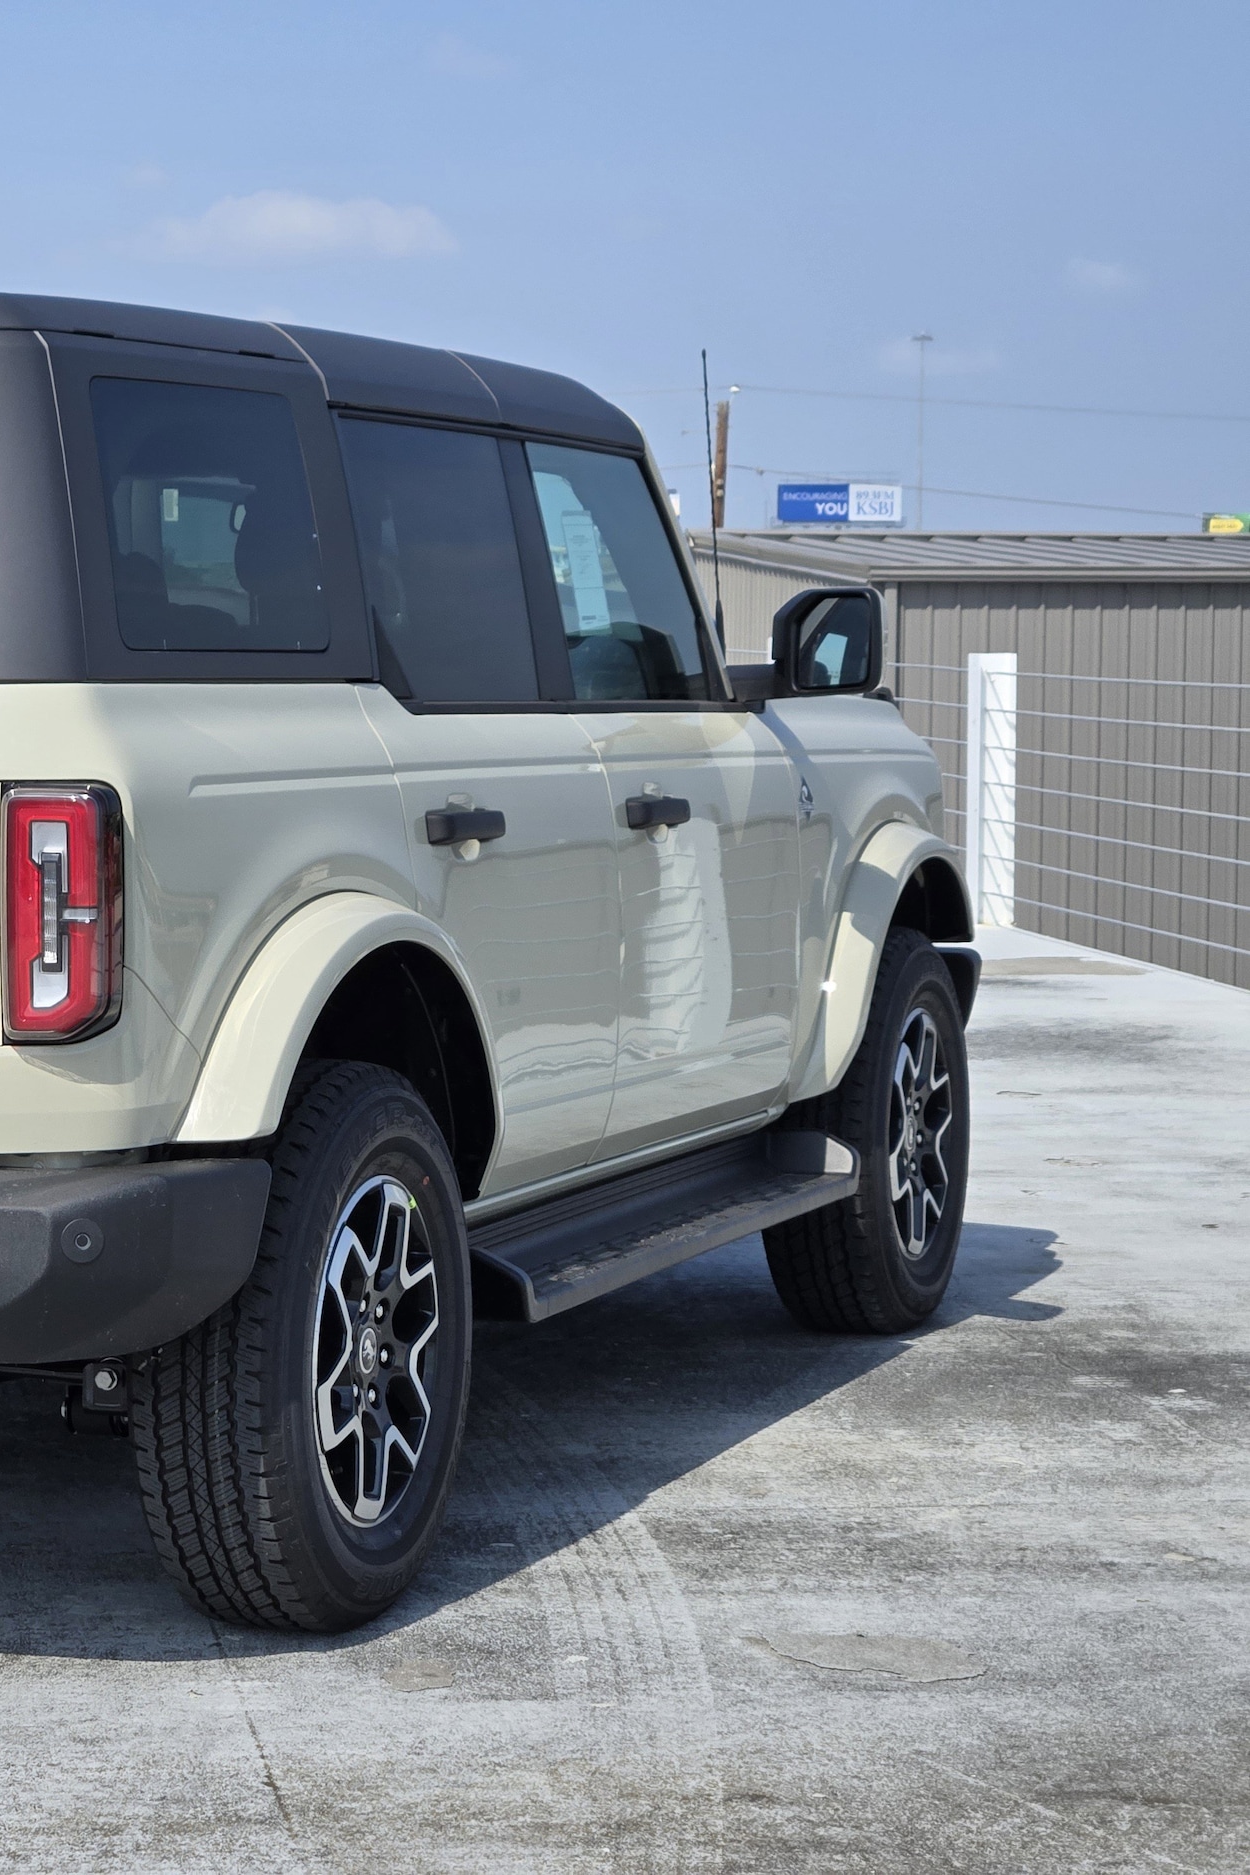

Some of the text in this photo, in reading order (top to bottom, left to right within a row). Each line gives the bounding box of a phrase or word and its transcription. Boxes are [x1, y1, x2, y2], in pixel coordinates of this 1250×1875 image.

[782, 491, 847, 501] ENCOURAGING
[815, 502, 847, 515] YOU
[855, 500, 895, 517] KSBJ
